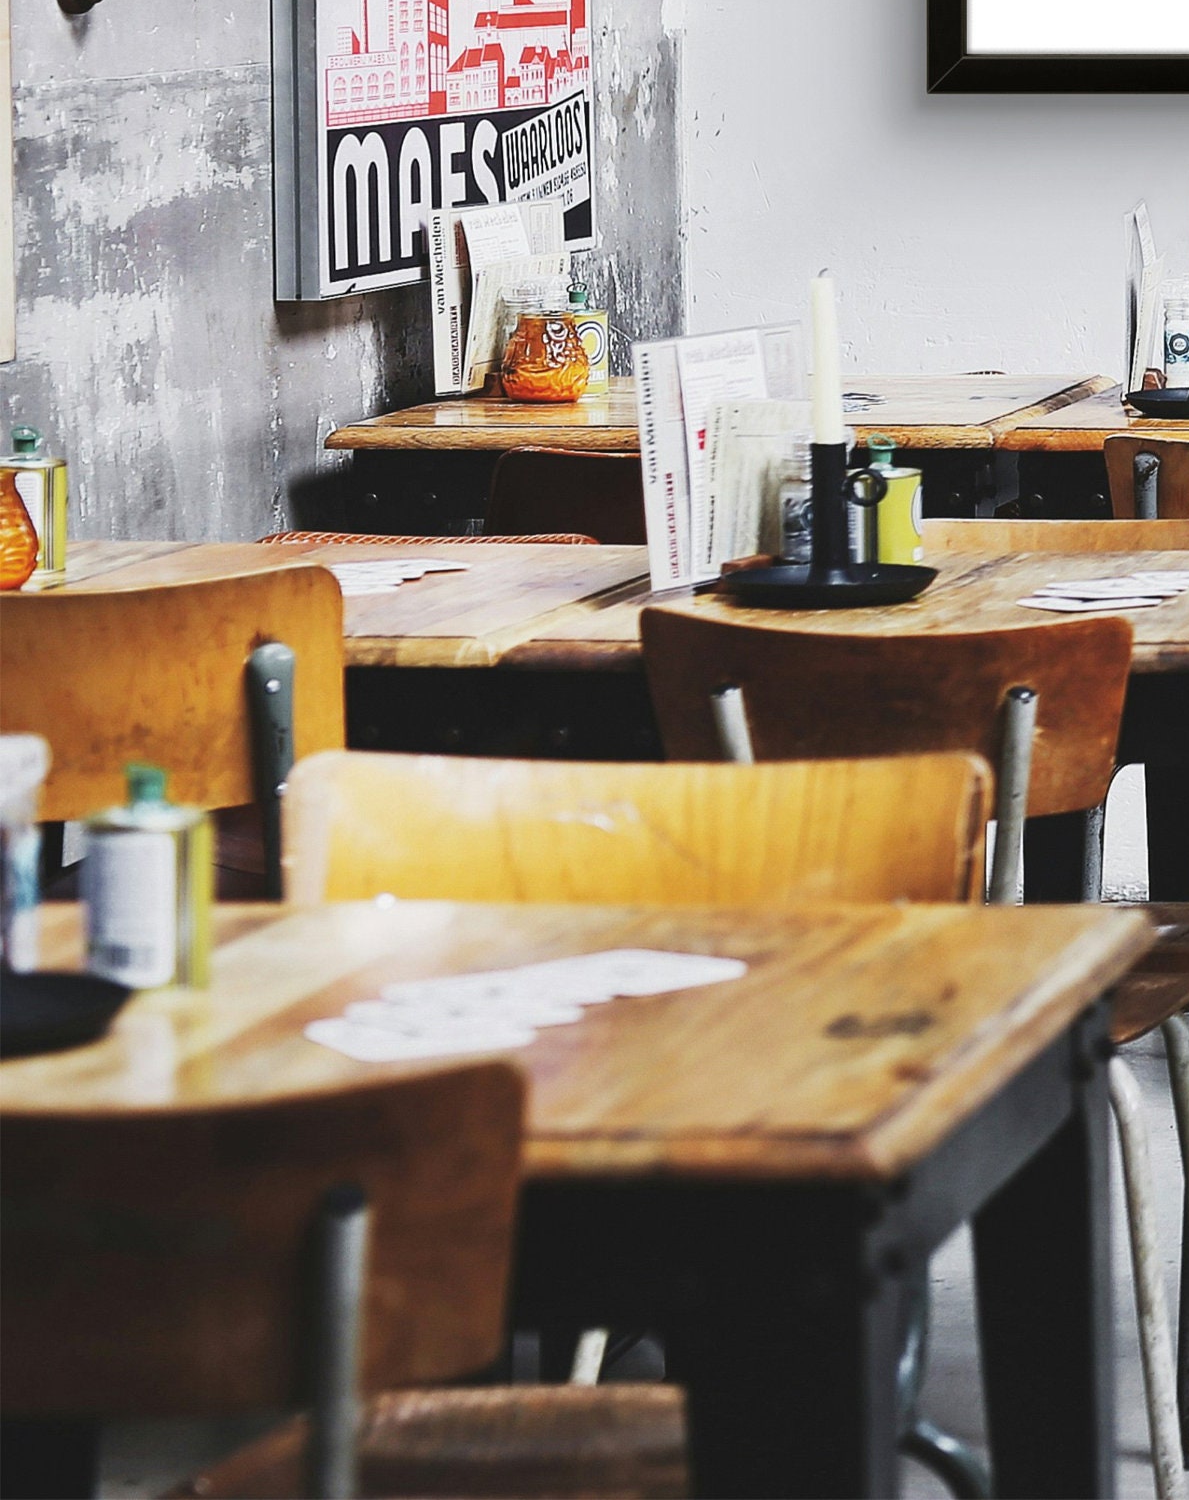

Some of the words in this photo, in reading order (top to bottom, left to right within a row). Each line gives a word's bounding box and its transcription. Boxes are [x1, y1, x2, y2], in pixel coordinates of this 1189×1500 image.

[506, 101, 582, 190] WAARLOOS
[333, 117, 500, 270] MAES
[432, 215, 445, 286] Mechelen
[433, 287, 445, 315] van
